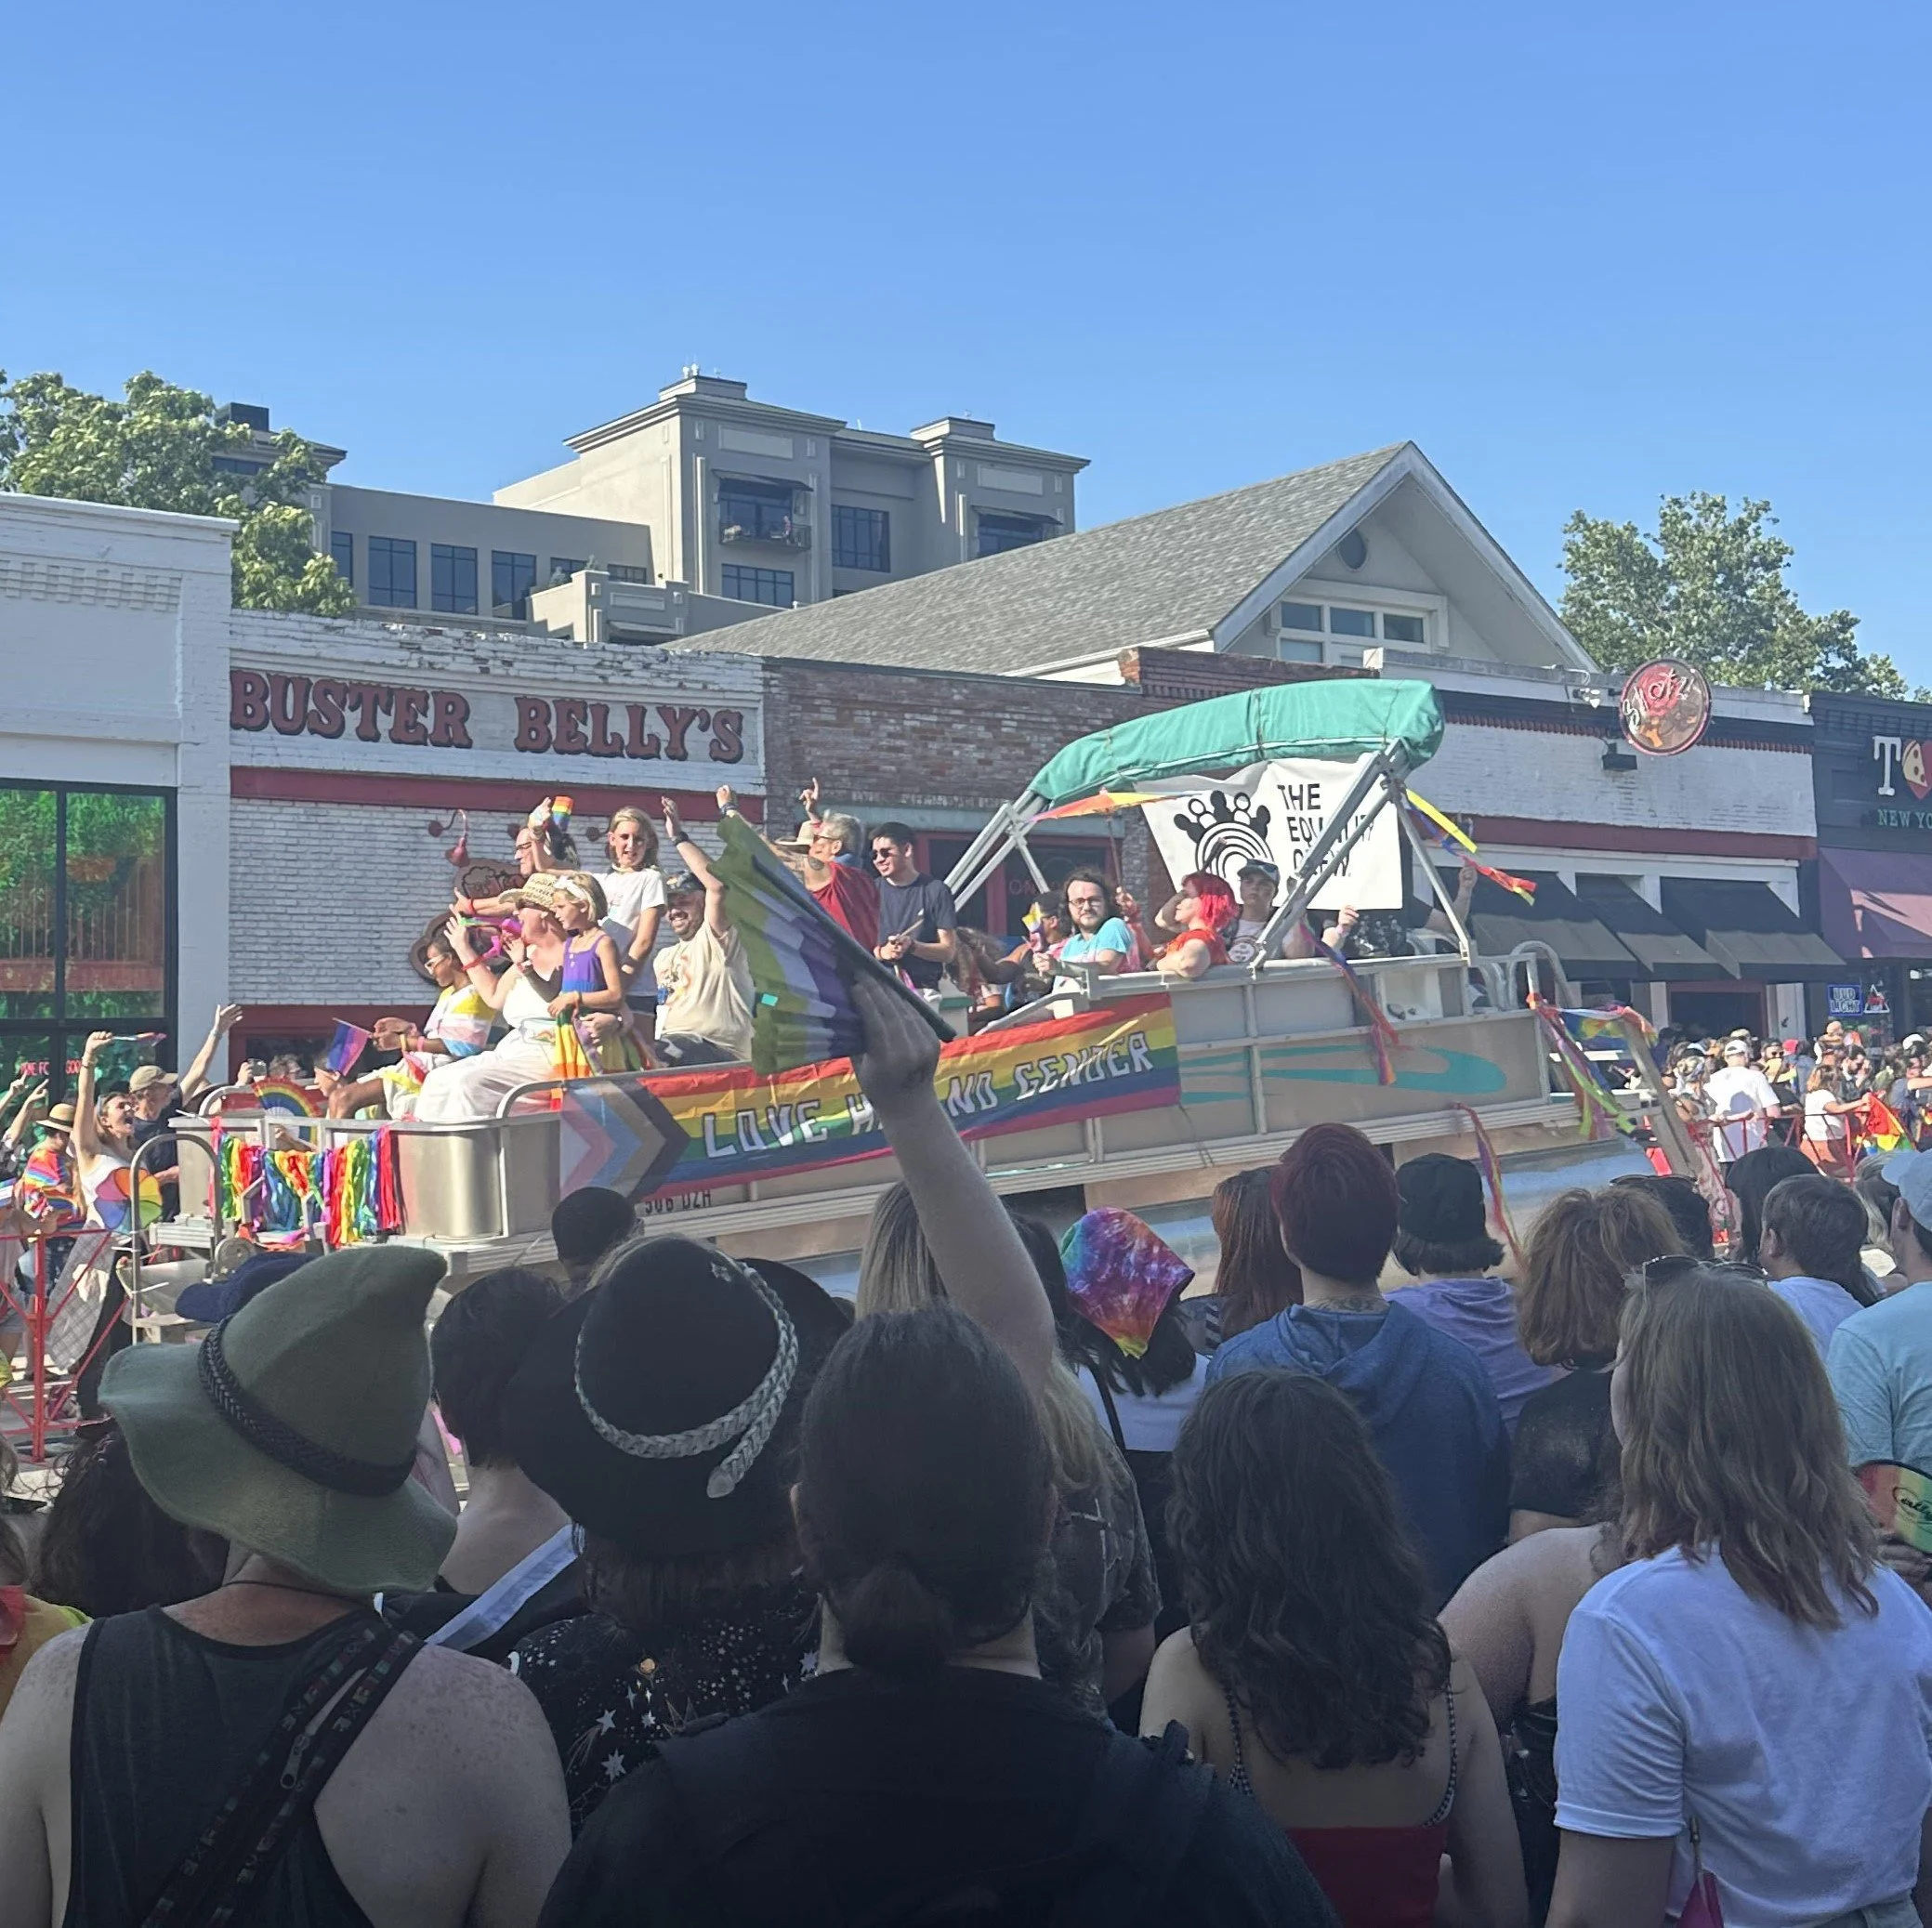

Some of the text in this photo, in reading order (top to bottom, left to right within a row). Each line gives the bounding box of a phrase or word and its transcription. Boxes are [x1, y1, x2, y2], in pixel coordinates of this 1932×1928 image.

[230, 670, 743, 764] BUSTER BELLY'S
[1277, 783, 1321, 811] THE
[1877, 808, 1911, 827] NEW
[703, 1098, 828, 1159] LOVE
[945, 1069, 998, 1117] NO
[1013, 1030, 1153, 1101] GENDER
